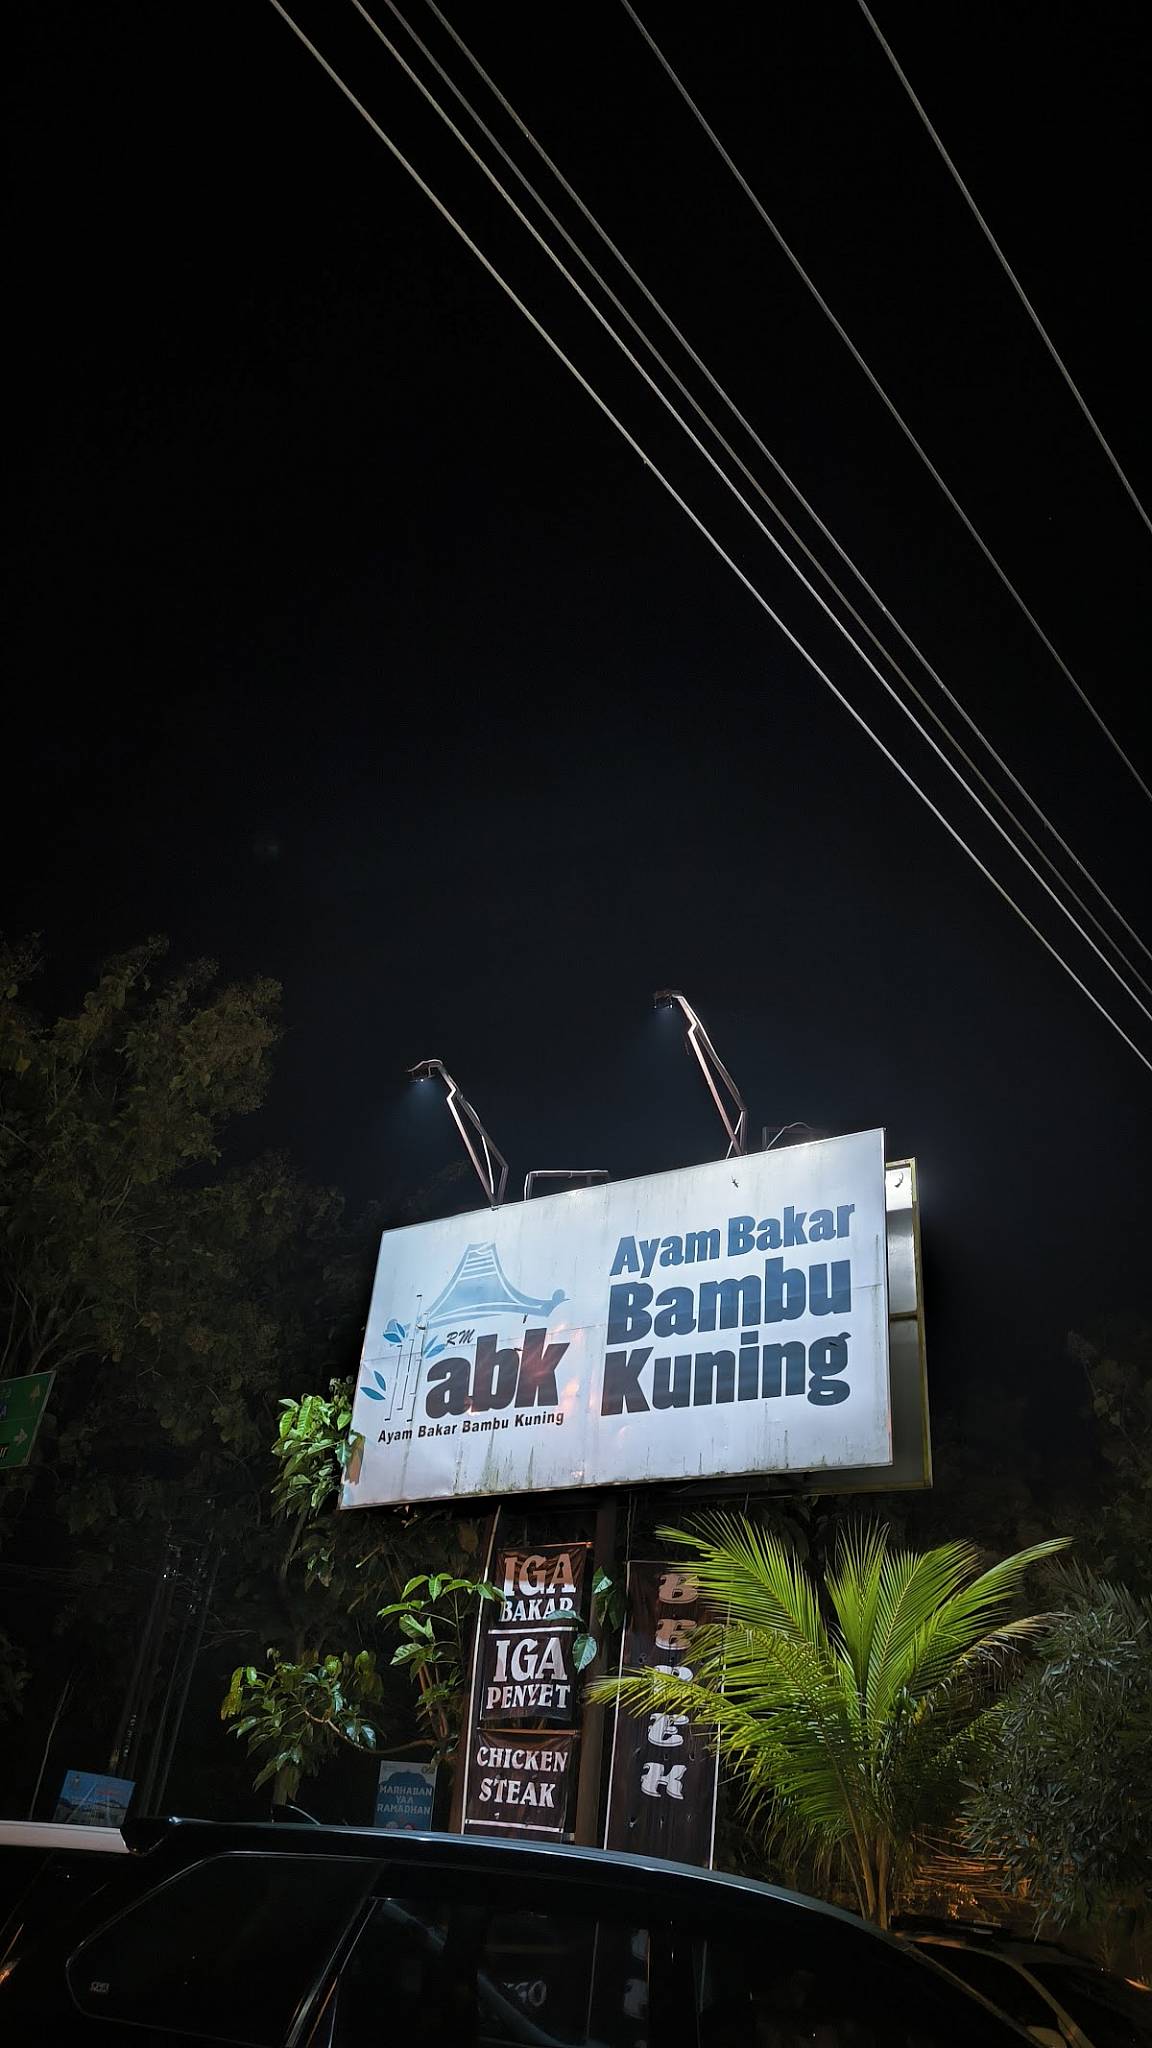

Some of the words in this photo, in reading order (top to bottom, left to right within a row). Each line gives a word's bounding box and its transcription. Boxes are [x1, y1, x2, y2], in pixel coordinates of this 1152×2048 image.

[609, 1228, 721, 1279] Ayam
[727, 1203, 856, 1258] Bakar
[607, 1256, 852, 1345] Bambu
[446, 1328, 476, 1346] RM
[425, 1327, 571, 1419] abk
[600, 1331, 852, 1417] Kuning
[377, 1428, 413, 1445] Ayam
[417, 1423, 458, 1438] Bakar
[462, 1417, 509, 1433] Bambu
[514, 1411, 565, 1427] Kuning
[503, 1552, 577, 1596] IGA
[492, 1637, 568, 1682] IGA
[485, 1683, 571, 1710] PENYET
[476, 1746, 569, 1773] CHICKEN
[478, 1778, 556, 1809] STEAK
